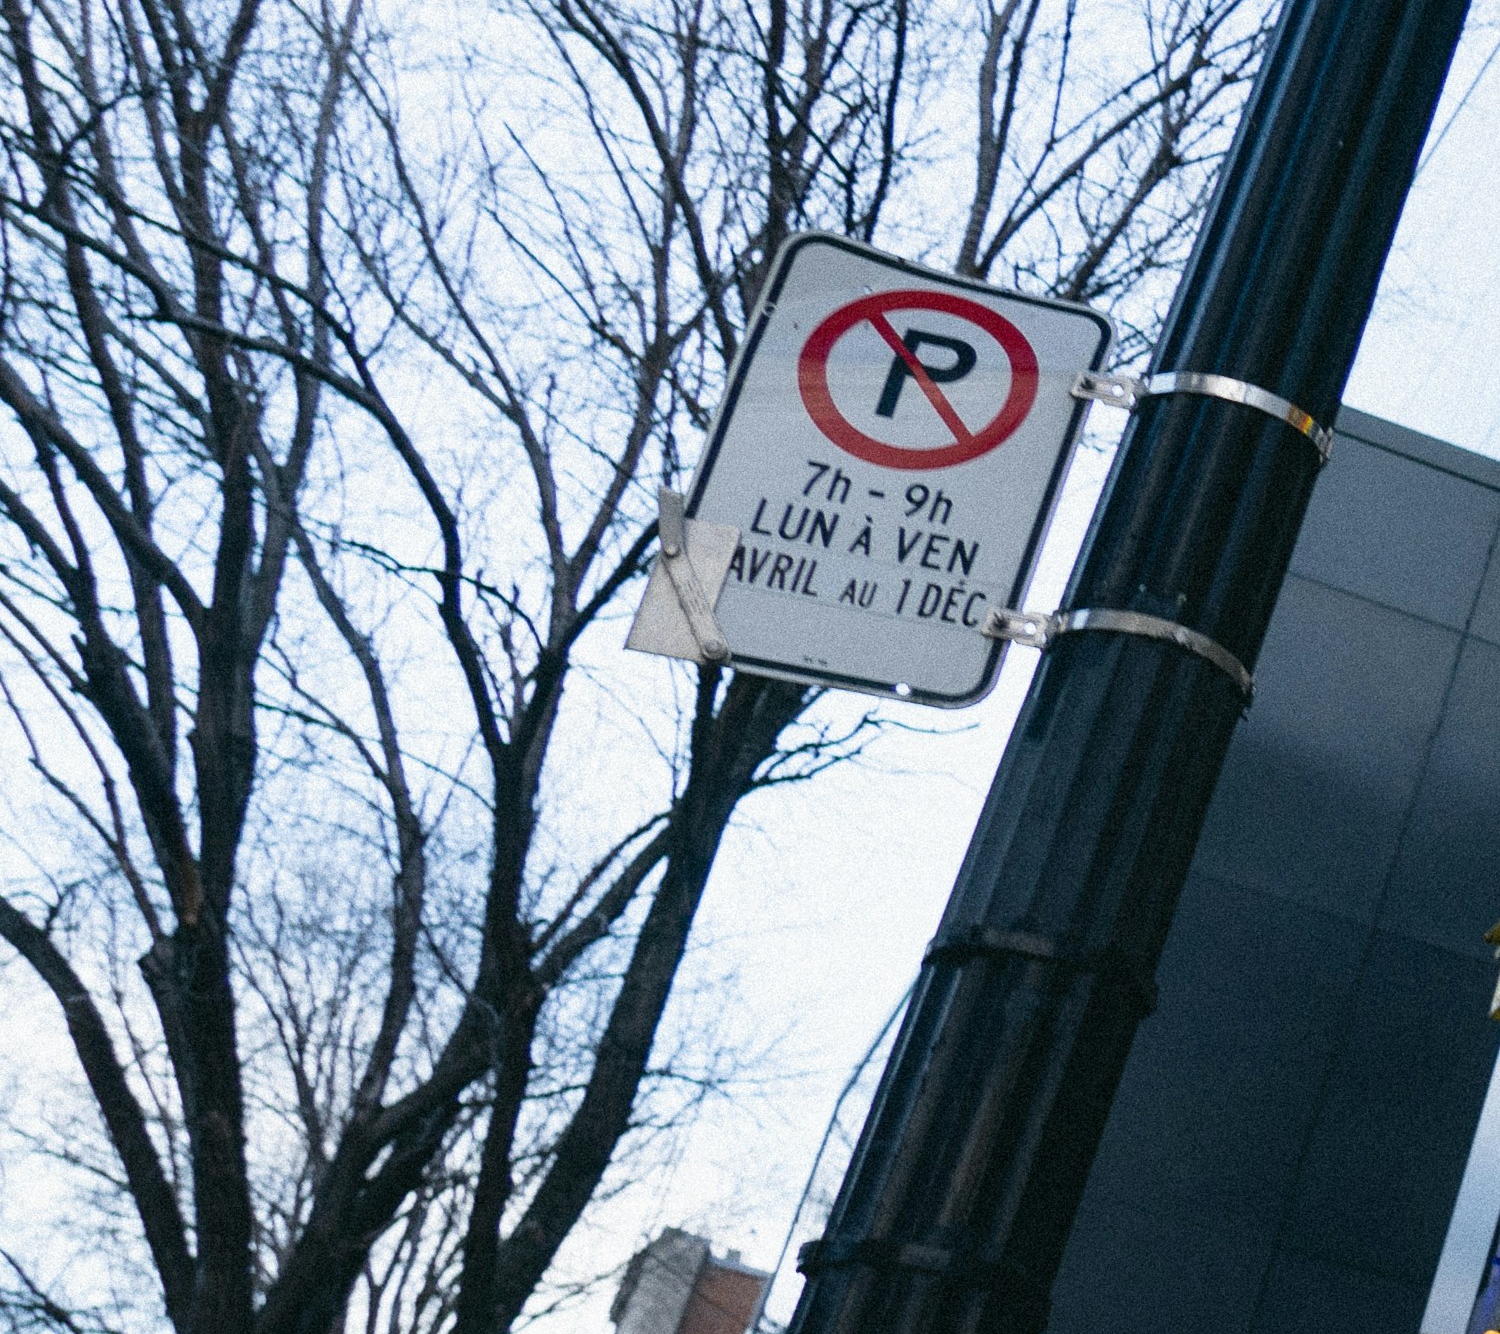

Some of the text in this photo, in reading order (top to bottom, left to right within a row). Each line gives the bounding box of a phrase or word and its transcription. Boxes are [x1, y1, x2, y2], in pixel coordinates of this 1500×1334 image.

[801, 461, 853, 504] 7h
[904, 484, 954, 525] 9h
[751, 498, 979, 577] LUN À VEN
[729, 545, 987, 628] AVRIL AU 1 DÉC
